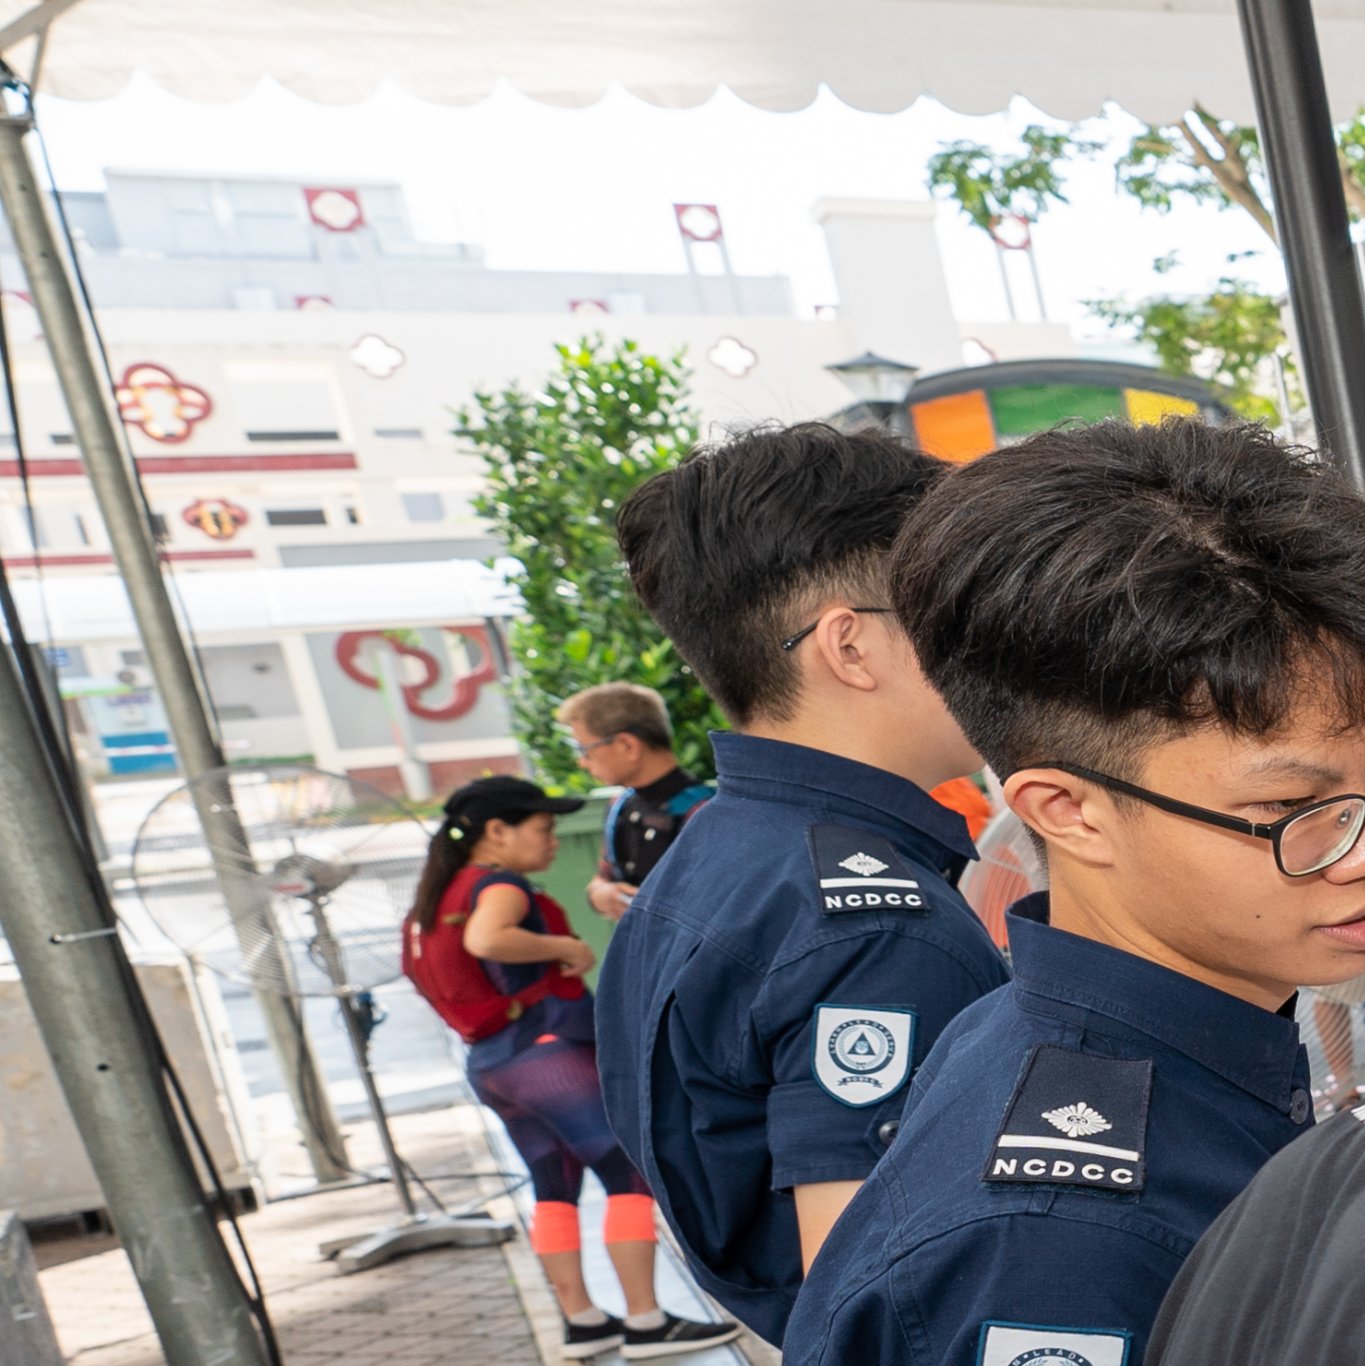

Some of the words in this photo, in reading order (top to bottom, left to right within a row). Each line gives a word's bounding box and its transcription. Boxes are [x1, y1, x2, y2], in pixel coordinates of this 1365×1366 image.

[825, 893, 922, 909] NCDCC
[992, 1158, 1133, 1184] NCDCC
[1033, 1349, 1076, 1360] LEAD
